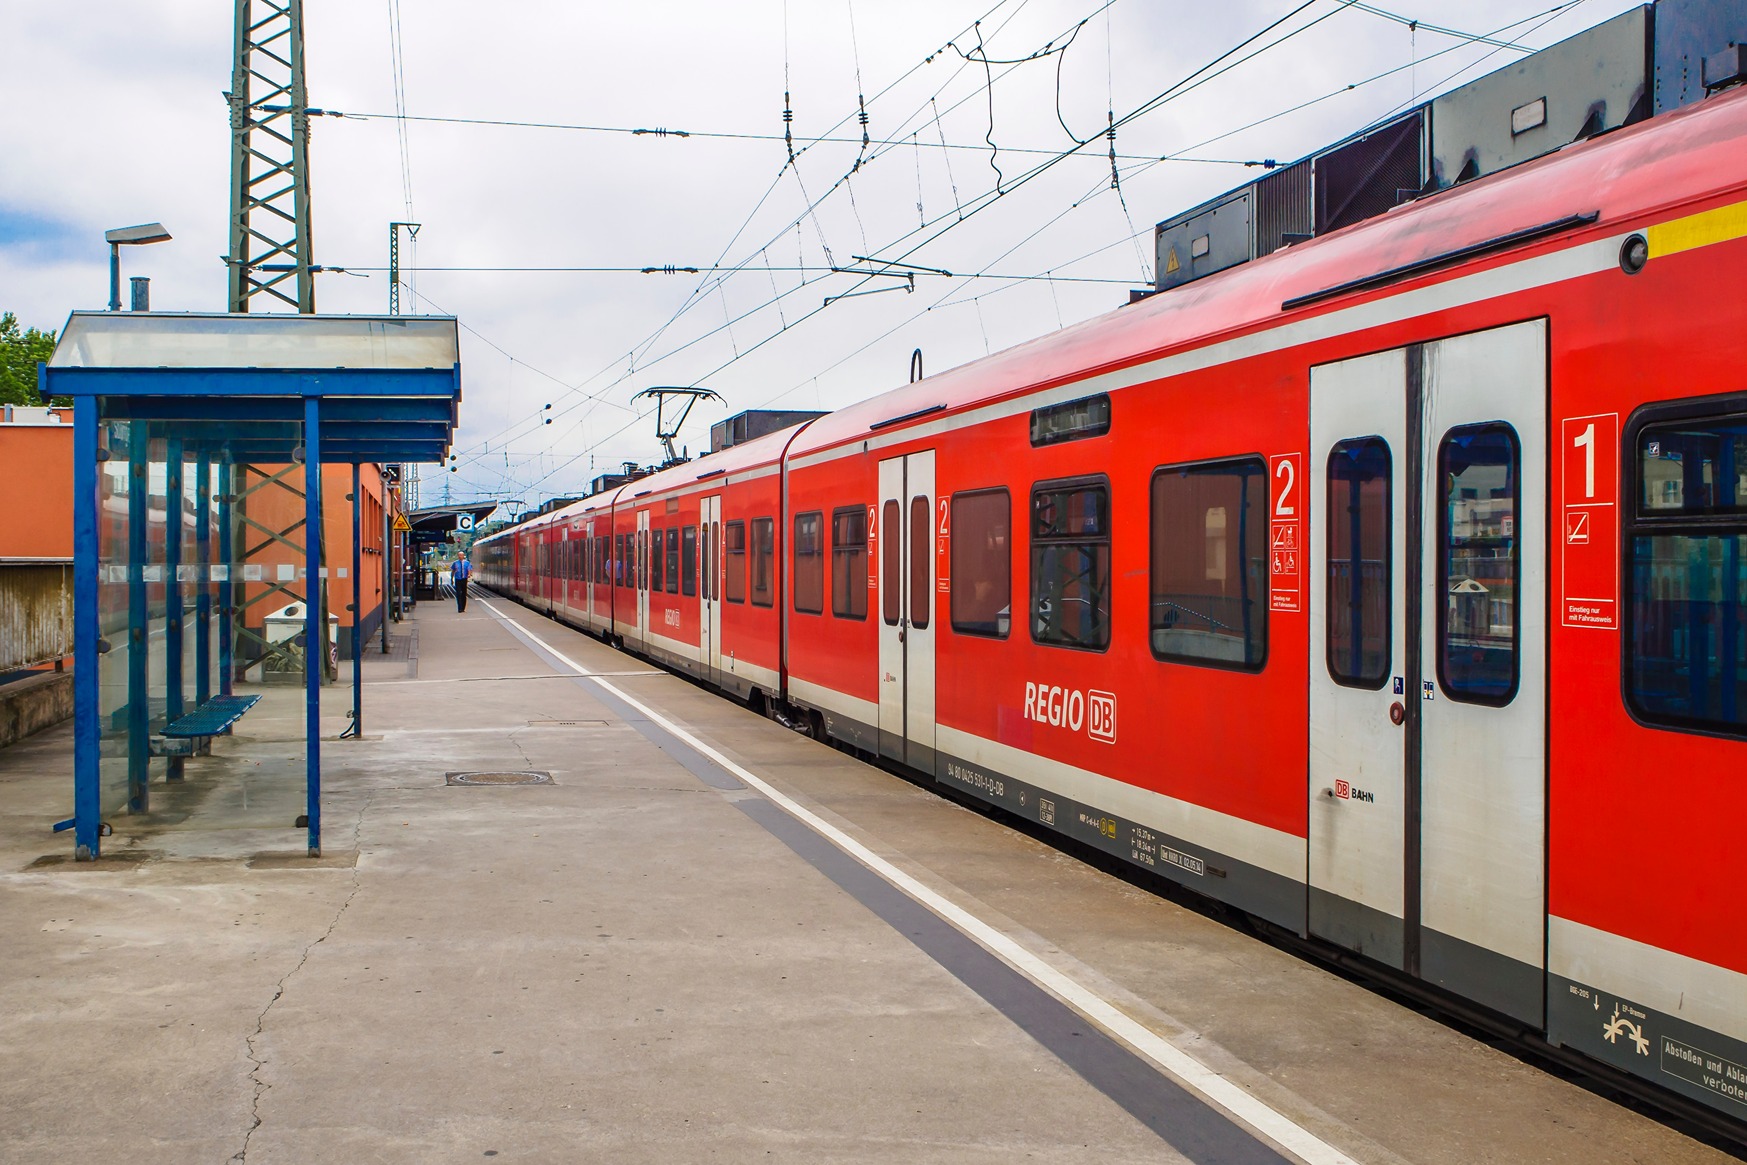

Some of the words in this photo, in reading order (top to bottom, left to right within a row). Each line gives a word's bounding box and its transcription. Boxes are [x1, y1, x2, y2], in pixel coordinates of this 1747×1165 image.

[1574, 423, 1595, 498] 1
[1275, 459, 1295, 516] 2
[459, 516, 471, 529] C
[869, 507, 876, 538] 2
[940, 499, 948, 534] 2
[1568, 605, 1590, 614] Einstieg
[1578, 614, 1612, 623] Fahrausweis
[1024, 681, 1084, 732] REGIO
[1090, 695, 1114, 738] DB
[947, 763, 954, 776] 94
[954, 765, 961, 779] 80
[961, 768, 974, 784] 0425
[1337, 781, 1348, 797] DB
[1352, 788, 1374, 803] BAHN
[1665, 1041, 1702, 1066] Abstoßen
[1706, 1060, 1722, 1074] und
[1726, 1065, 1747, 1084] Abla
